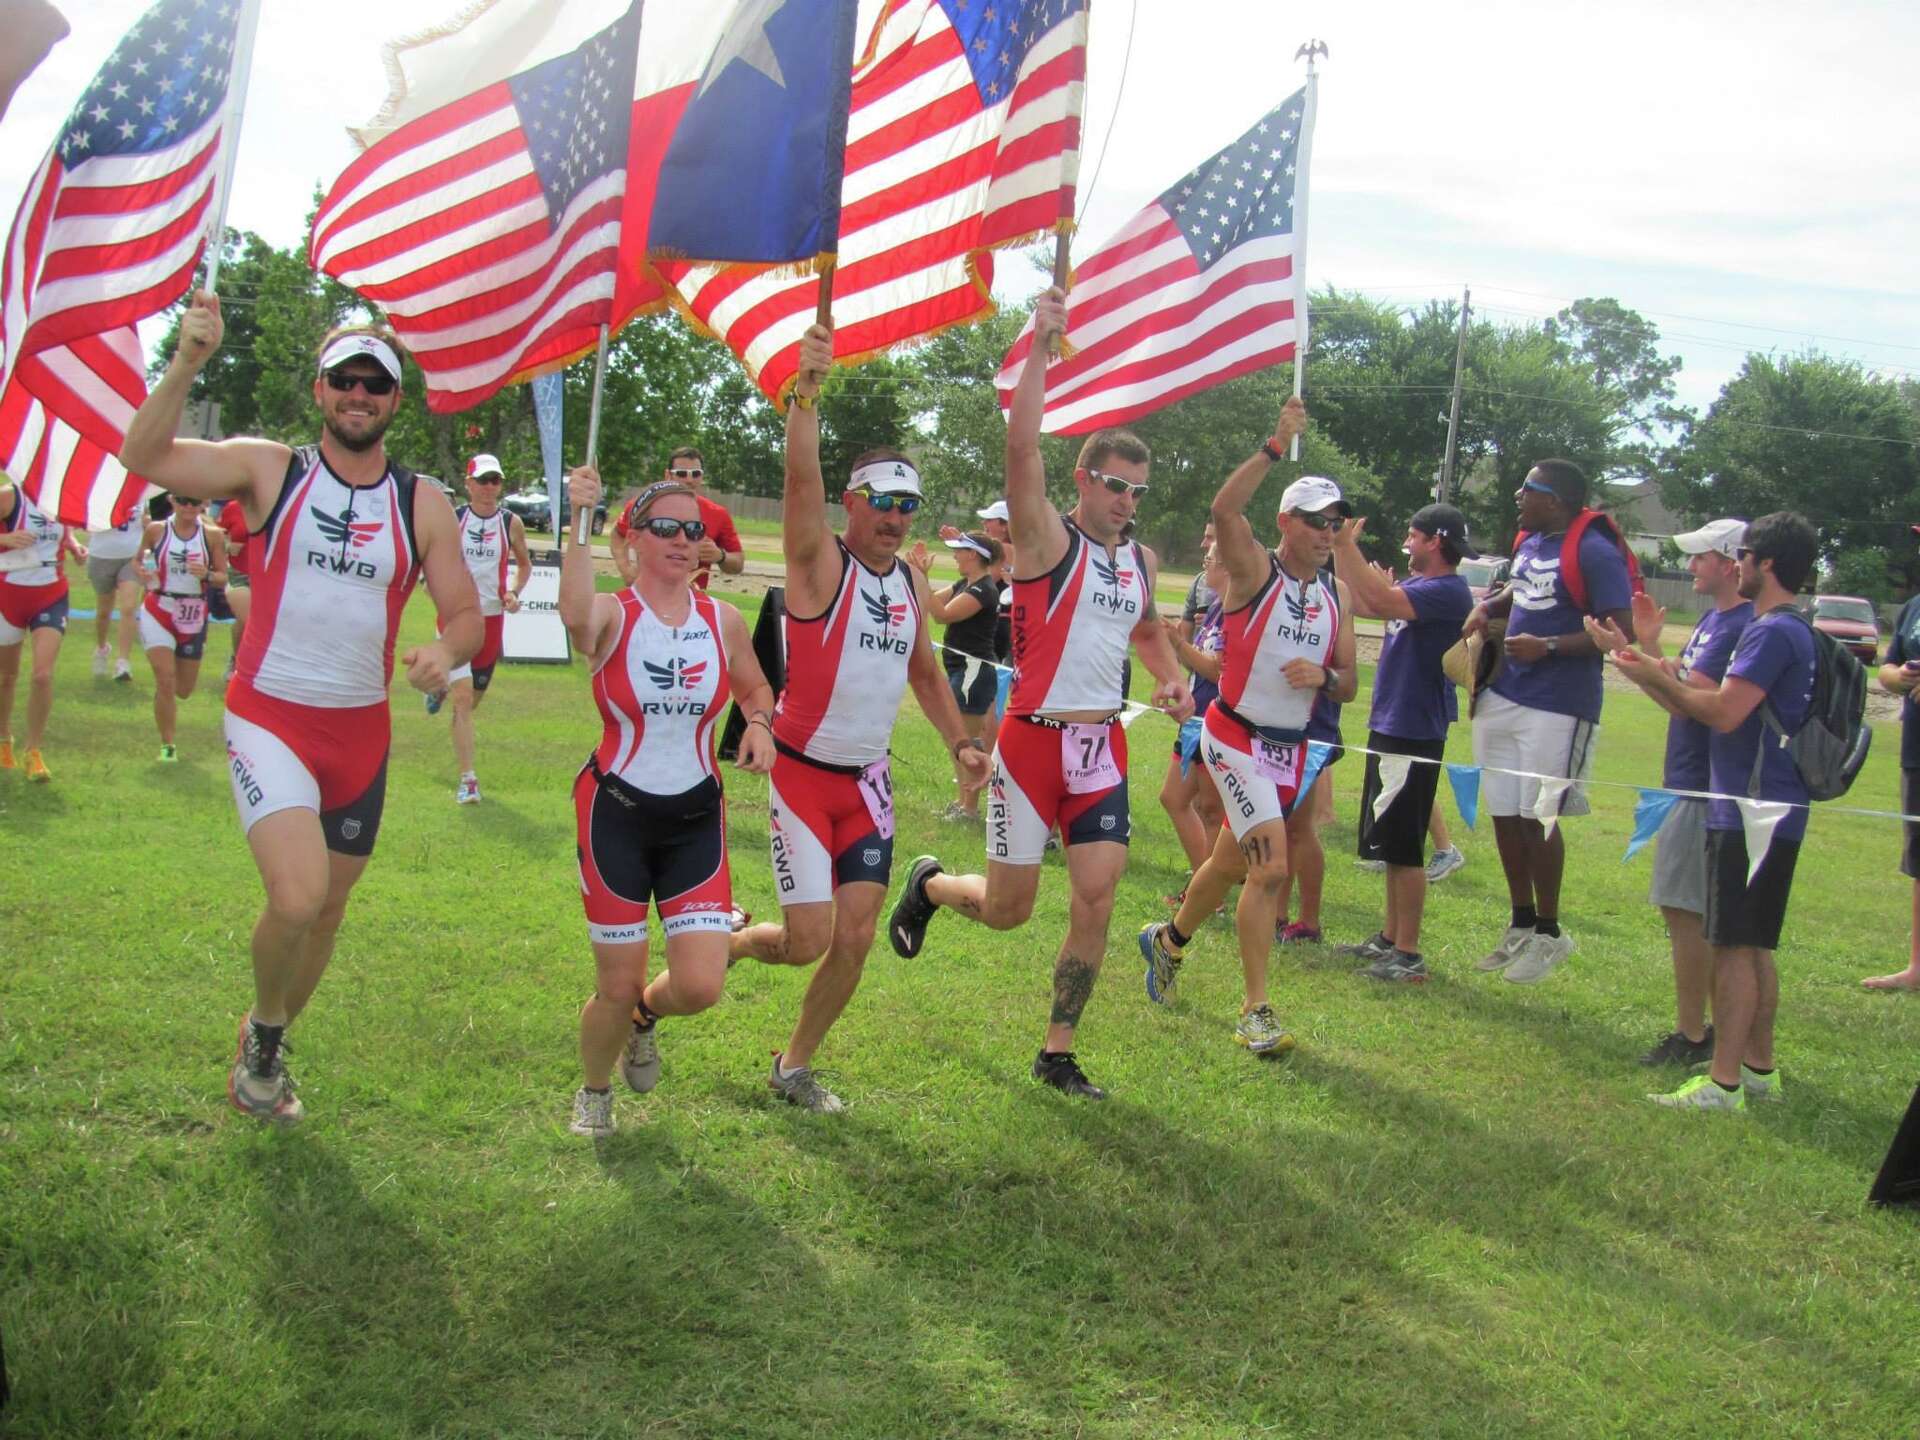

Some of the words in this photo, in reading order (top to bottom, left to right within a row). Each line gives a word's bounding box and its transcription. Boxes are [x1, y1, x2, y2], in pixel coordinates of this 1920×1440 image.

[465, 547, 496, 558] RWB
[307, 550, 377, 579] RWB
[178, 604, 200, 621] 316
[1092, 591, 1137, 614] RWB
[859, 632, 908, 655] RWB
[1277, 624, 1321, 646] RWB
[642, 702, 707, 716] RWB
[1043, 718, 1061, 729] TYR
[232, 758, 264, 807] RWB
[1223, 772, 1256, 819] RWB
[993, 803, 1009, 858] RWB
[772, 835, 796, 893] RWB
[668, 917, 697, 929] WEAR
[700, 916, 722, 926] THE
[600, 929, 635, 939] WEAR
